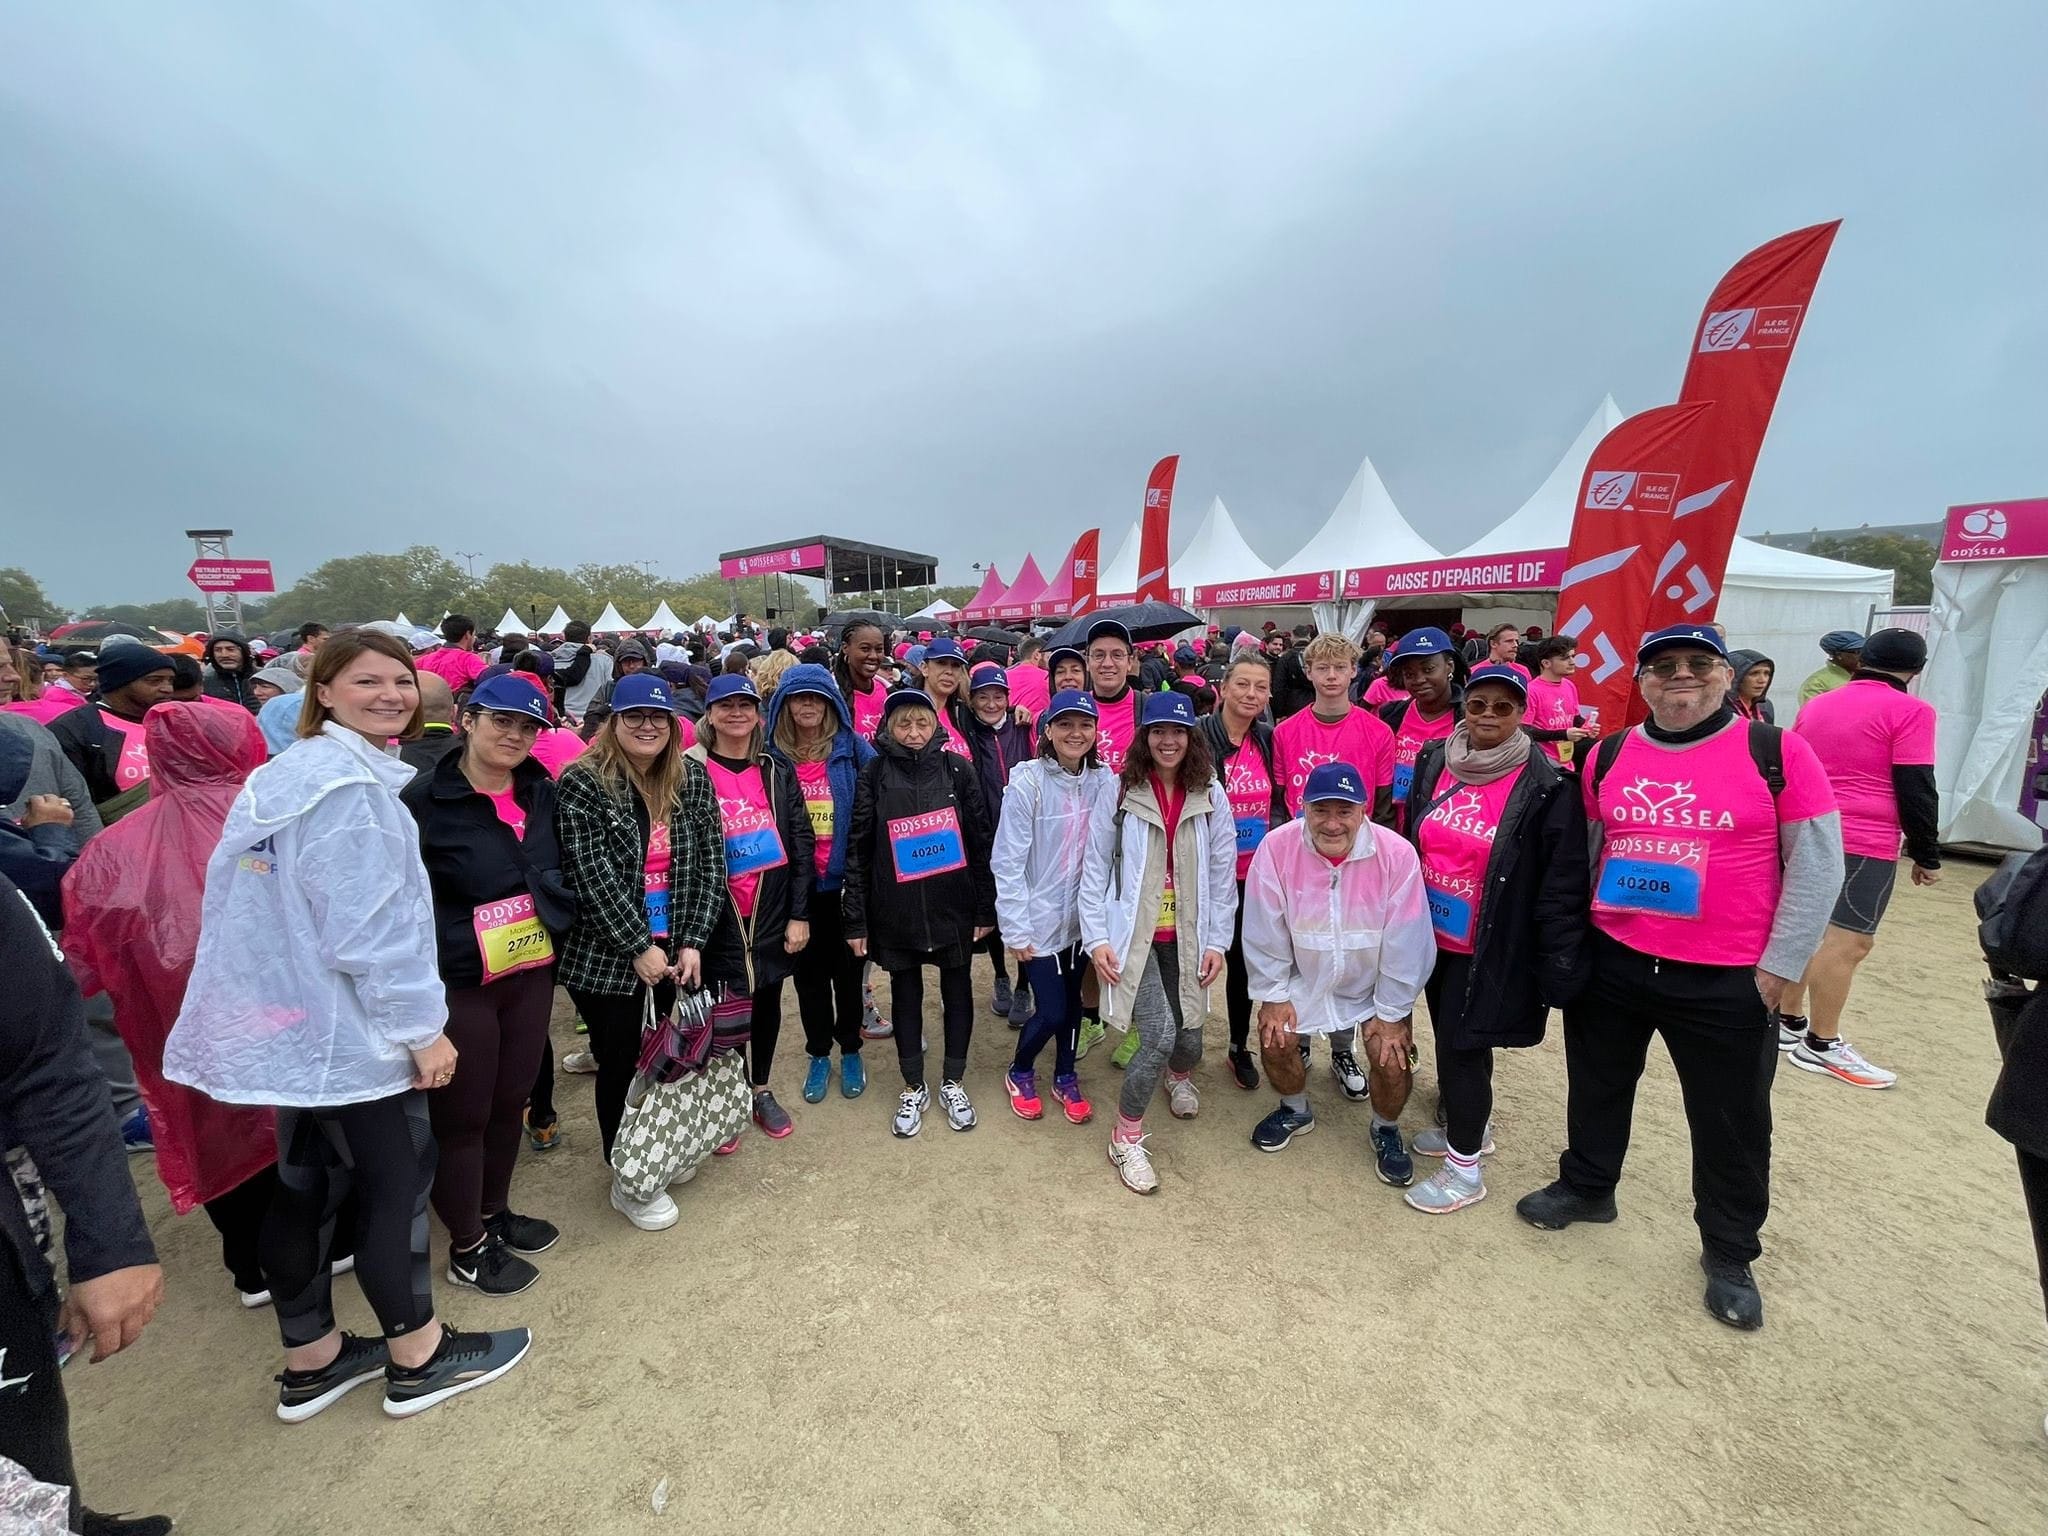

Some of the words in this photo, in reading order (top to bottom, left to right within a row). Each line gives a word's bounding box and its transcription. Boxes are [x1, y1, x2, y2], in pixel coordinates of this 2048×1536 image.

[1758, 327, 1790, 335] FRANCE
[1640, 492, 1670, 500] FRANCE
[1951, 543, 2006, 557] ODYSSEA
[1386, 571, 1429, 591] CAISSE
[1432, 565, 1513, 588] D'EPARGNE
[1518, 561, 1546, 583] IDF
[1216, 590, 1239, 603] CAISSE
[1240, 585, 1281, 602] D'EPARGNE
[1282, 583, 1297, 598] IDF
[893, 815, 944, 833] ODYSSEA
[1613, 806, 1735, 828] ODYSSEA
[728, 844, 761, 860] 40211
[911, 844, 946, 858] 40204
[1611, 837, 1681, 856] ODYSSEA
[1617, 876, 1671, 894] 40208
[508, 930, 544, 953] 27779
